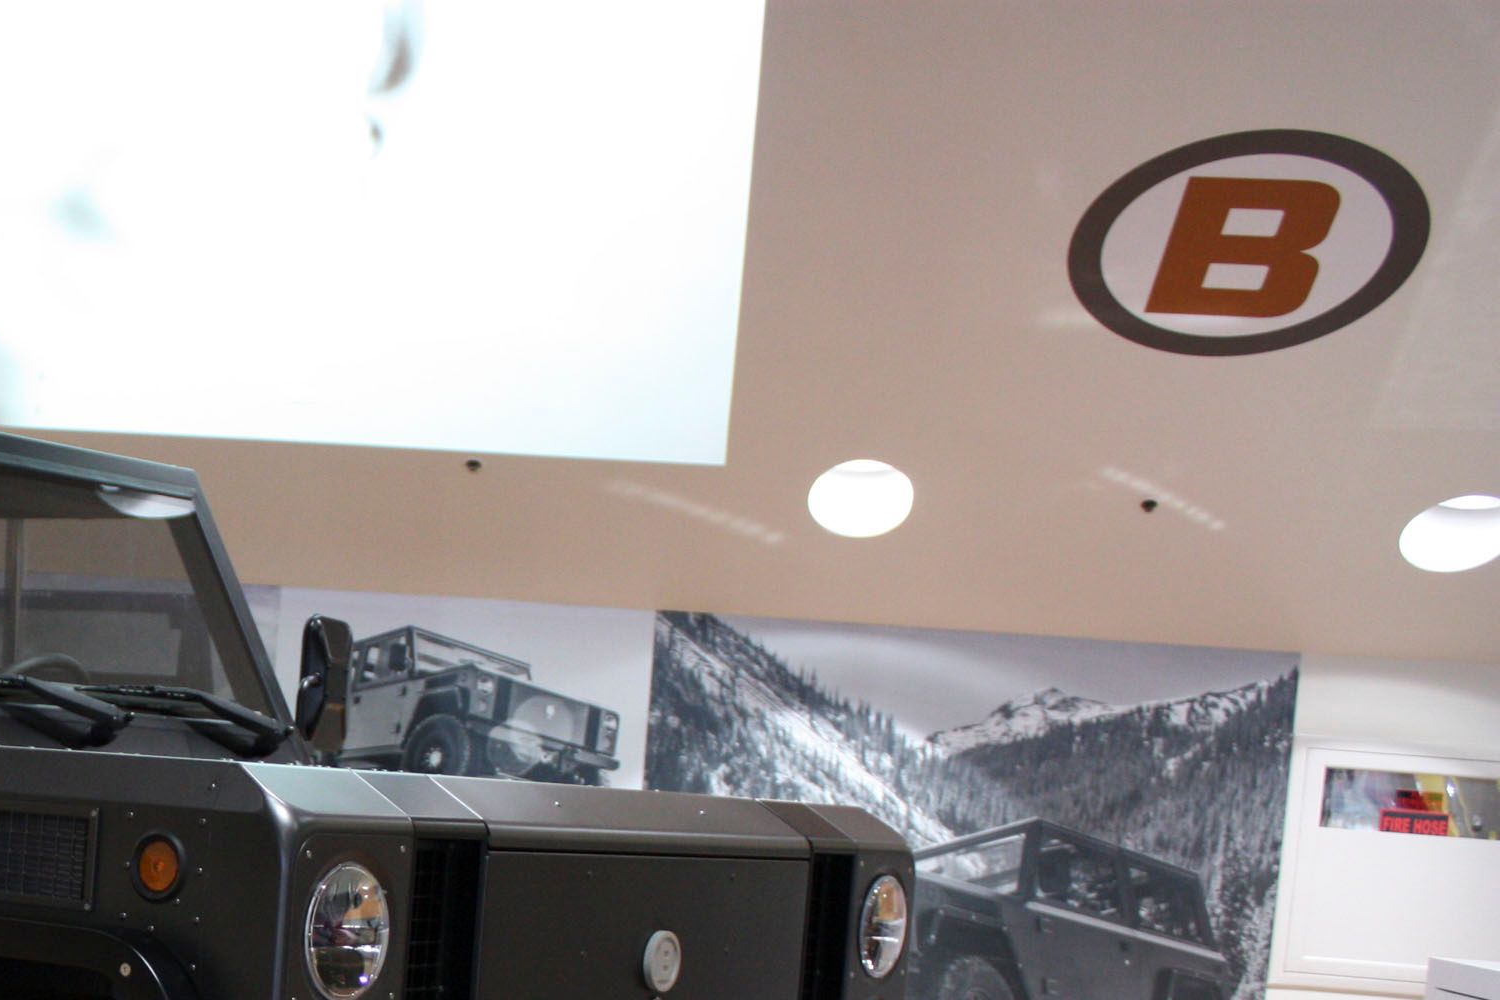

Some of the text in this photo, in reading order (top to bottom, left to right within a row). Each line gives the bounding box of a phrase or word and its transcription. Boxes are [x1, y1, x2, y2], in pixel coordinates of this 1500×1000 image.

[1144, 176, 1341, 318] B
[1382, 815, 1448, 836] FIRE HOSE
